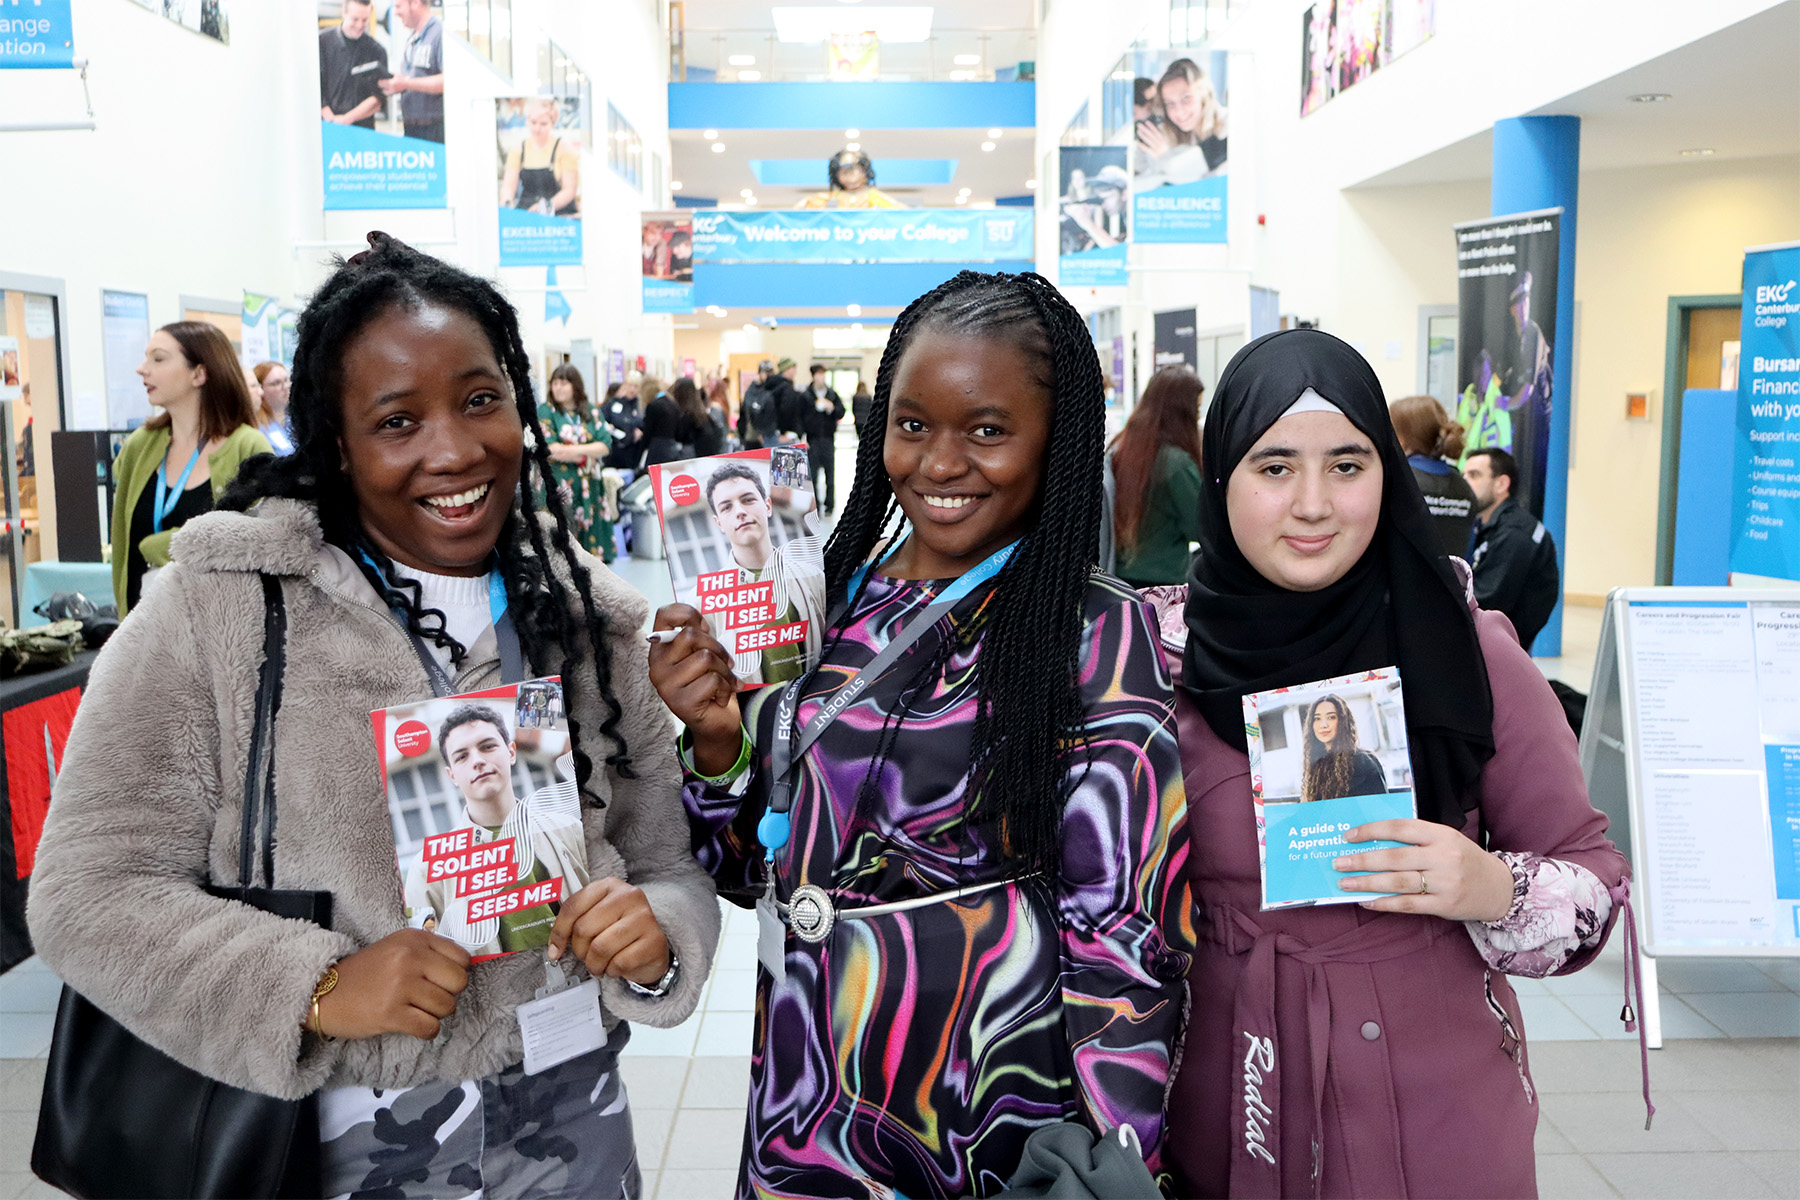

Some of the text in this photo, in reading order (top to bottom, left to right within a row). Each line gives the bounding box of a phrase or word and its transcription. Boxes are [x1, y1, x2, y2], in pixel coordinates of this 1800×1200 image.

[328, 151, 435, 169] AMBITION
[387, 172, 426, 181] students
[427, 172, 438, 181] to
[365, 181, 386, 191] their
[387, 181, 429, 192] potential
[1137, 197, 1222, 211] RESILIENCE
[502, 226, 576, 238] EXCELLENCE
[744, 223, 970, 244] Welcome to your College
[644, 287, 689, 297] RESPECT
[1756, 281, 1793, 304] EKC
[1755, 302, 1800, 316] Canterbur
[1755, 315, 1787, 329] College
[1751, 400, 1783, 417] with
[1749, 429, 1784, 443] Support
[1753, 455, 1794, 467] Travel costs
[1752, 470, 1785, 482] Uniforms
[1751, 485, 1777, 496] Course
[1751, 500, 1769, 511] Trips
[1749, 514, 1784, 527] Childcare
[1749, 528, 1769, 541] Food
[960, 563, 993, 586] College
[700, 572, 735, 592] THE
[704, 586, 770, 611] SOLENT
[728, 605, 773, 627] I SEE.
[1636, 611, 1664, 619] Careers
[1666, 611, 1680, 619] and
[1681, 611, 1725, 621] Progression
[738, 624, 805, 650] SEES ME.
[431, 665, 454, 697] ollege
[814, 677, 865, 730] STUDENT
[778, 700, 791, 740] EKC
[396, 729, 428, 738] Southampton
[397, 736, 413, 744] Solent
[398, 741, 419, 749] University
[1288, 822, 1351, 837] A guide to
[427, 832, 469, 857] THE
[1288, 834, 1349, 850] Apprentic
[431, 844, 511, 878] SOLENT
[1288, 853, 1301, 861] for
[1310, 849, 1338, 859] future
[459, 866, 514, 894] I SEE.
[470, 882, 558, 920] SEES ME.
